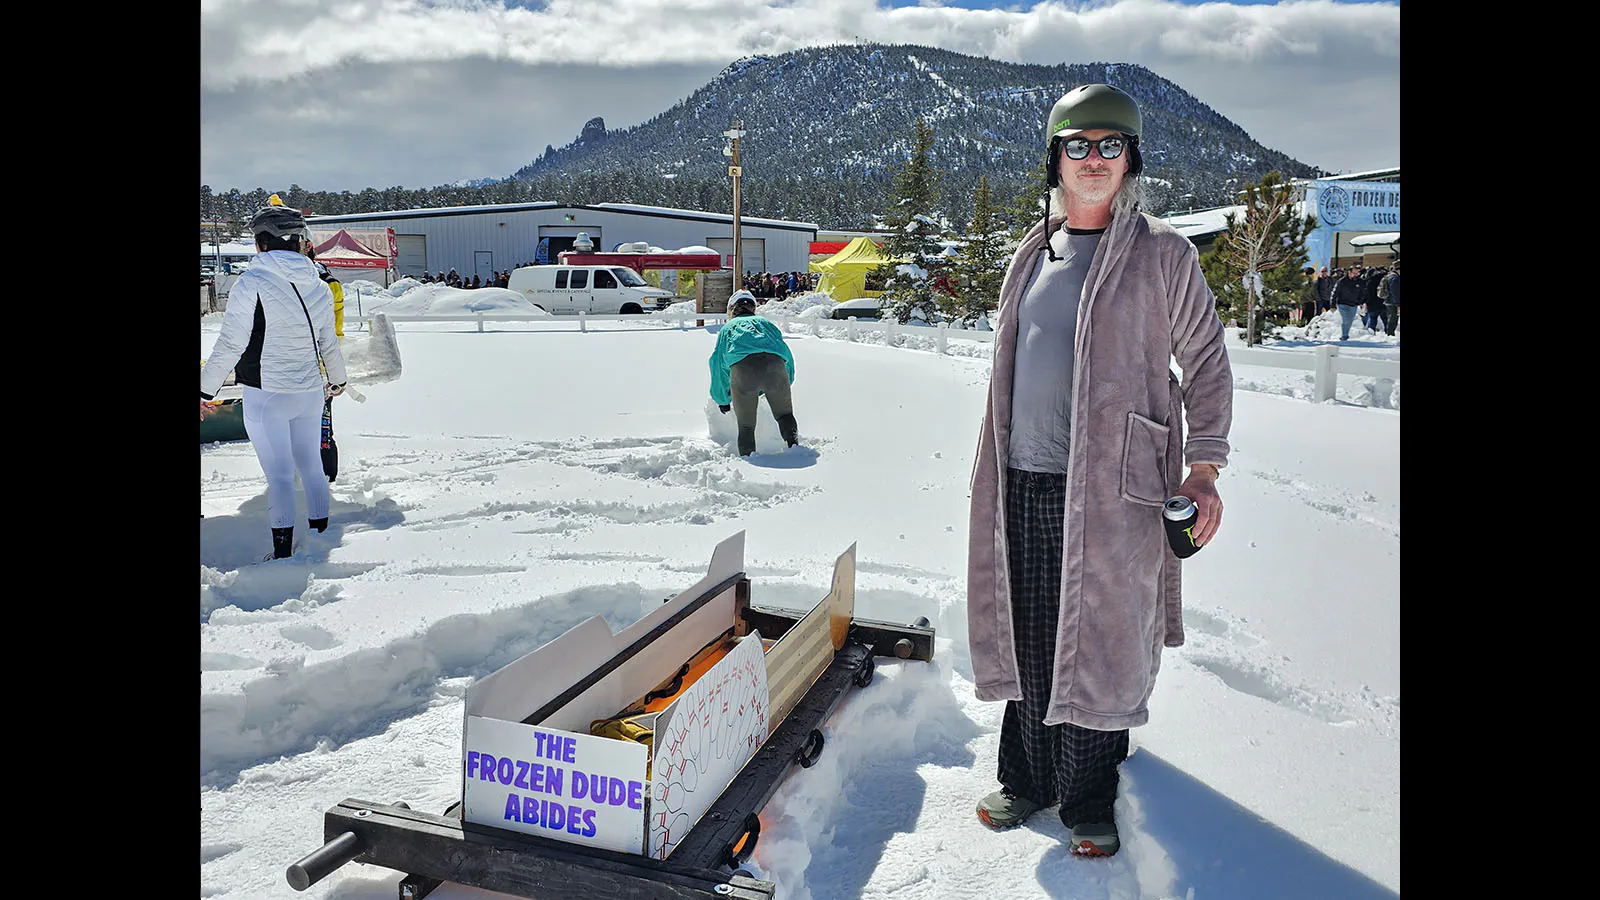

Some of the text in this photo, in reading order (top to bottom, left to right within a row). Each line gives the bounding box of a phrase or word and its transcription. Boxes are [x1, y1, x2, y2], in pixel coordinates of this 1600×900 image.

[1053, 118, 1071, 133] bern
[1352, 191, 1386, 208] FROZEN
[1388, 193, 1400, 208] DE
[1373, 212, 1397, 225] ESTES
[534, 731, 577, 764] THE
[467, 751, 643, 810] FROZEN DUDE
[504, 793, 597, 838] ABIDES
